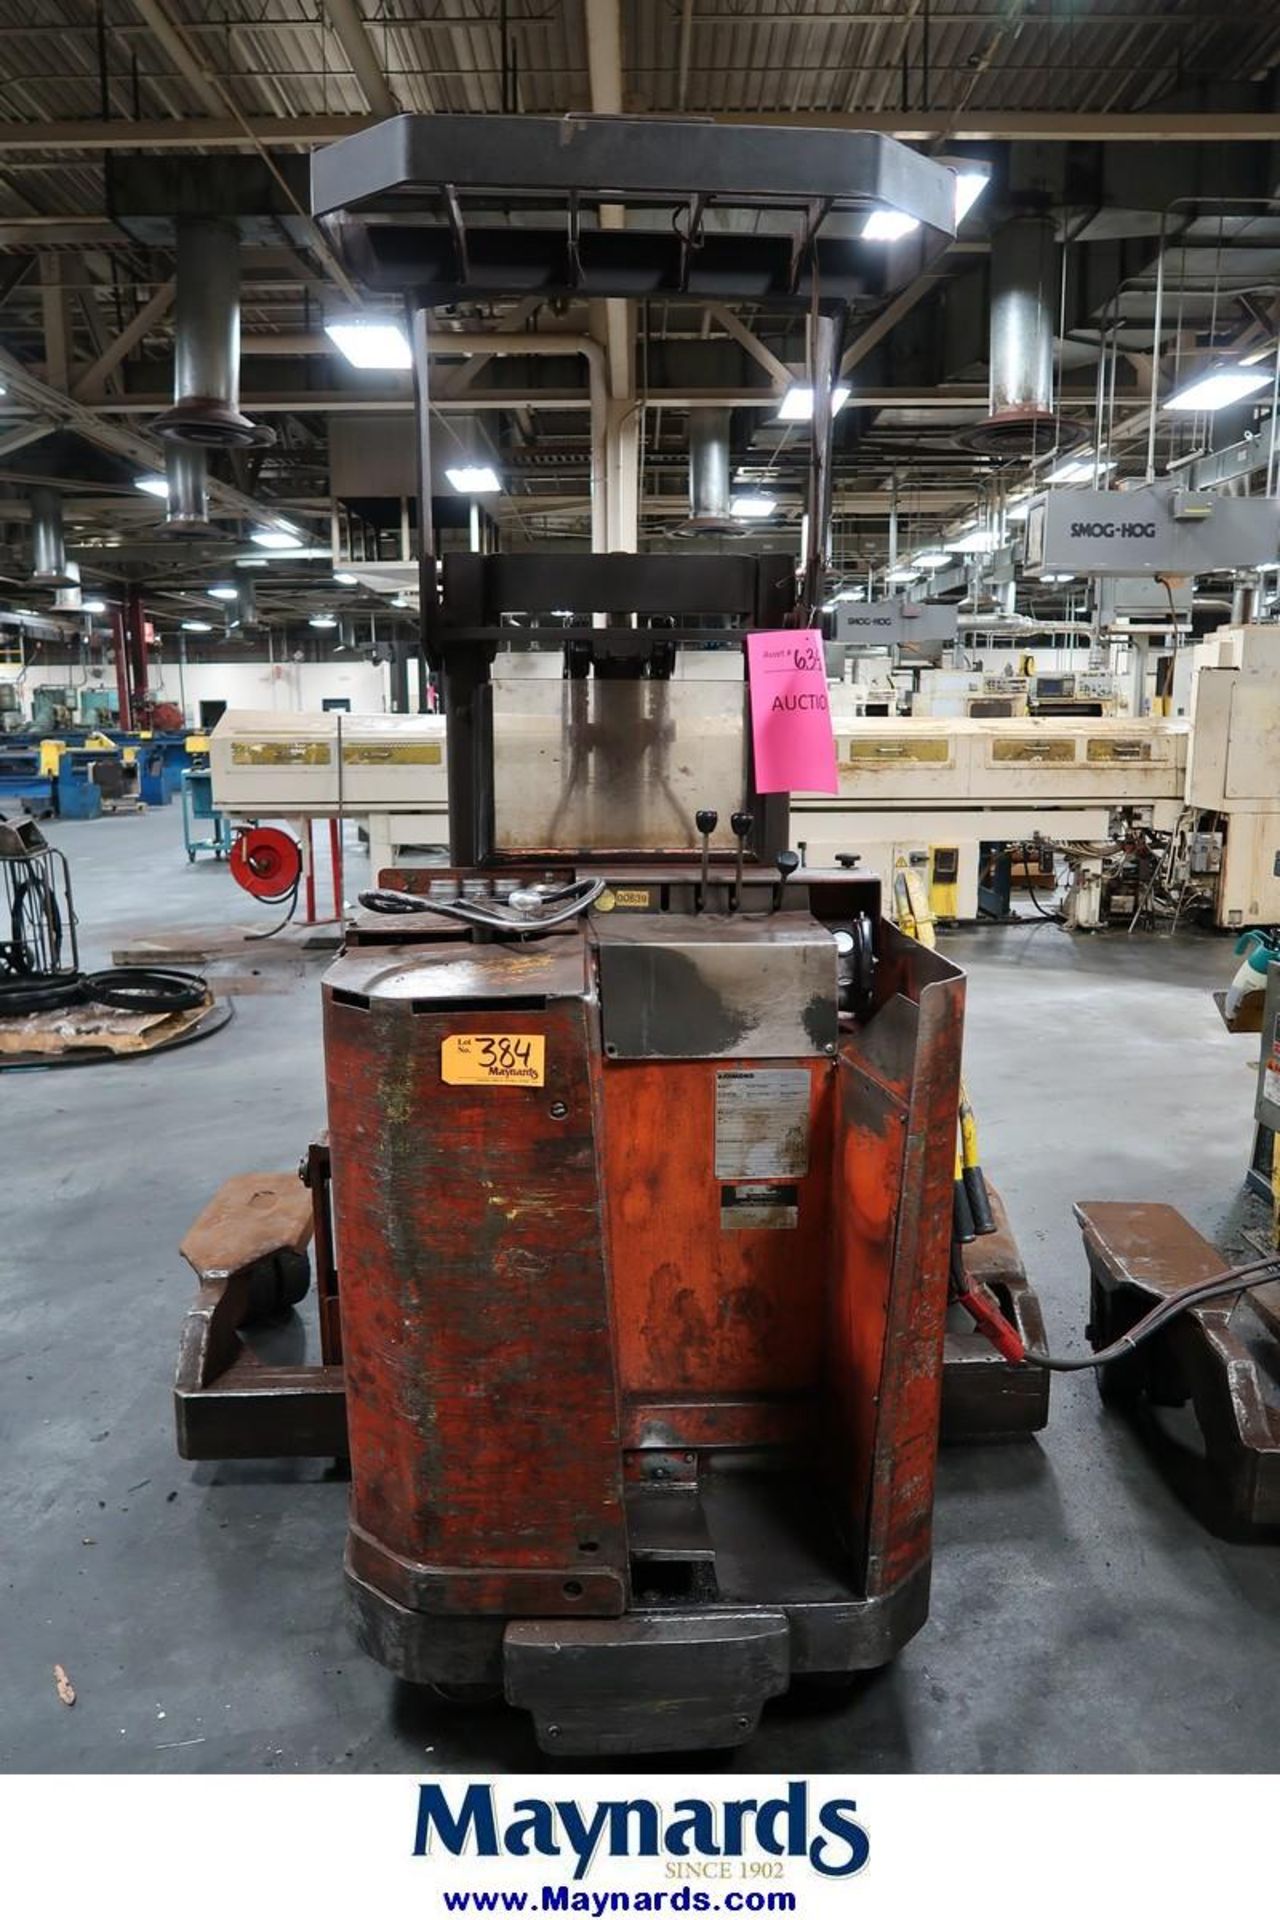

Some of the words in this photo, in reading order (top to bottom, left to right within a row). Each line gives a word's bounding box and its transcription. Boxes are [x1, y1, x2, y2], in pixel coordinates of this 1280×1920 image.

[1071, 523, 1155, 538] SMOG-HOG
[475, 1038, 531, 1068] 384
[488, 1067, 539, 1079] Maynards
